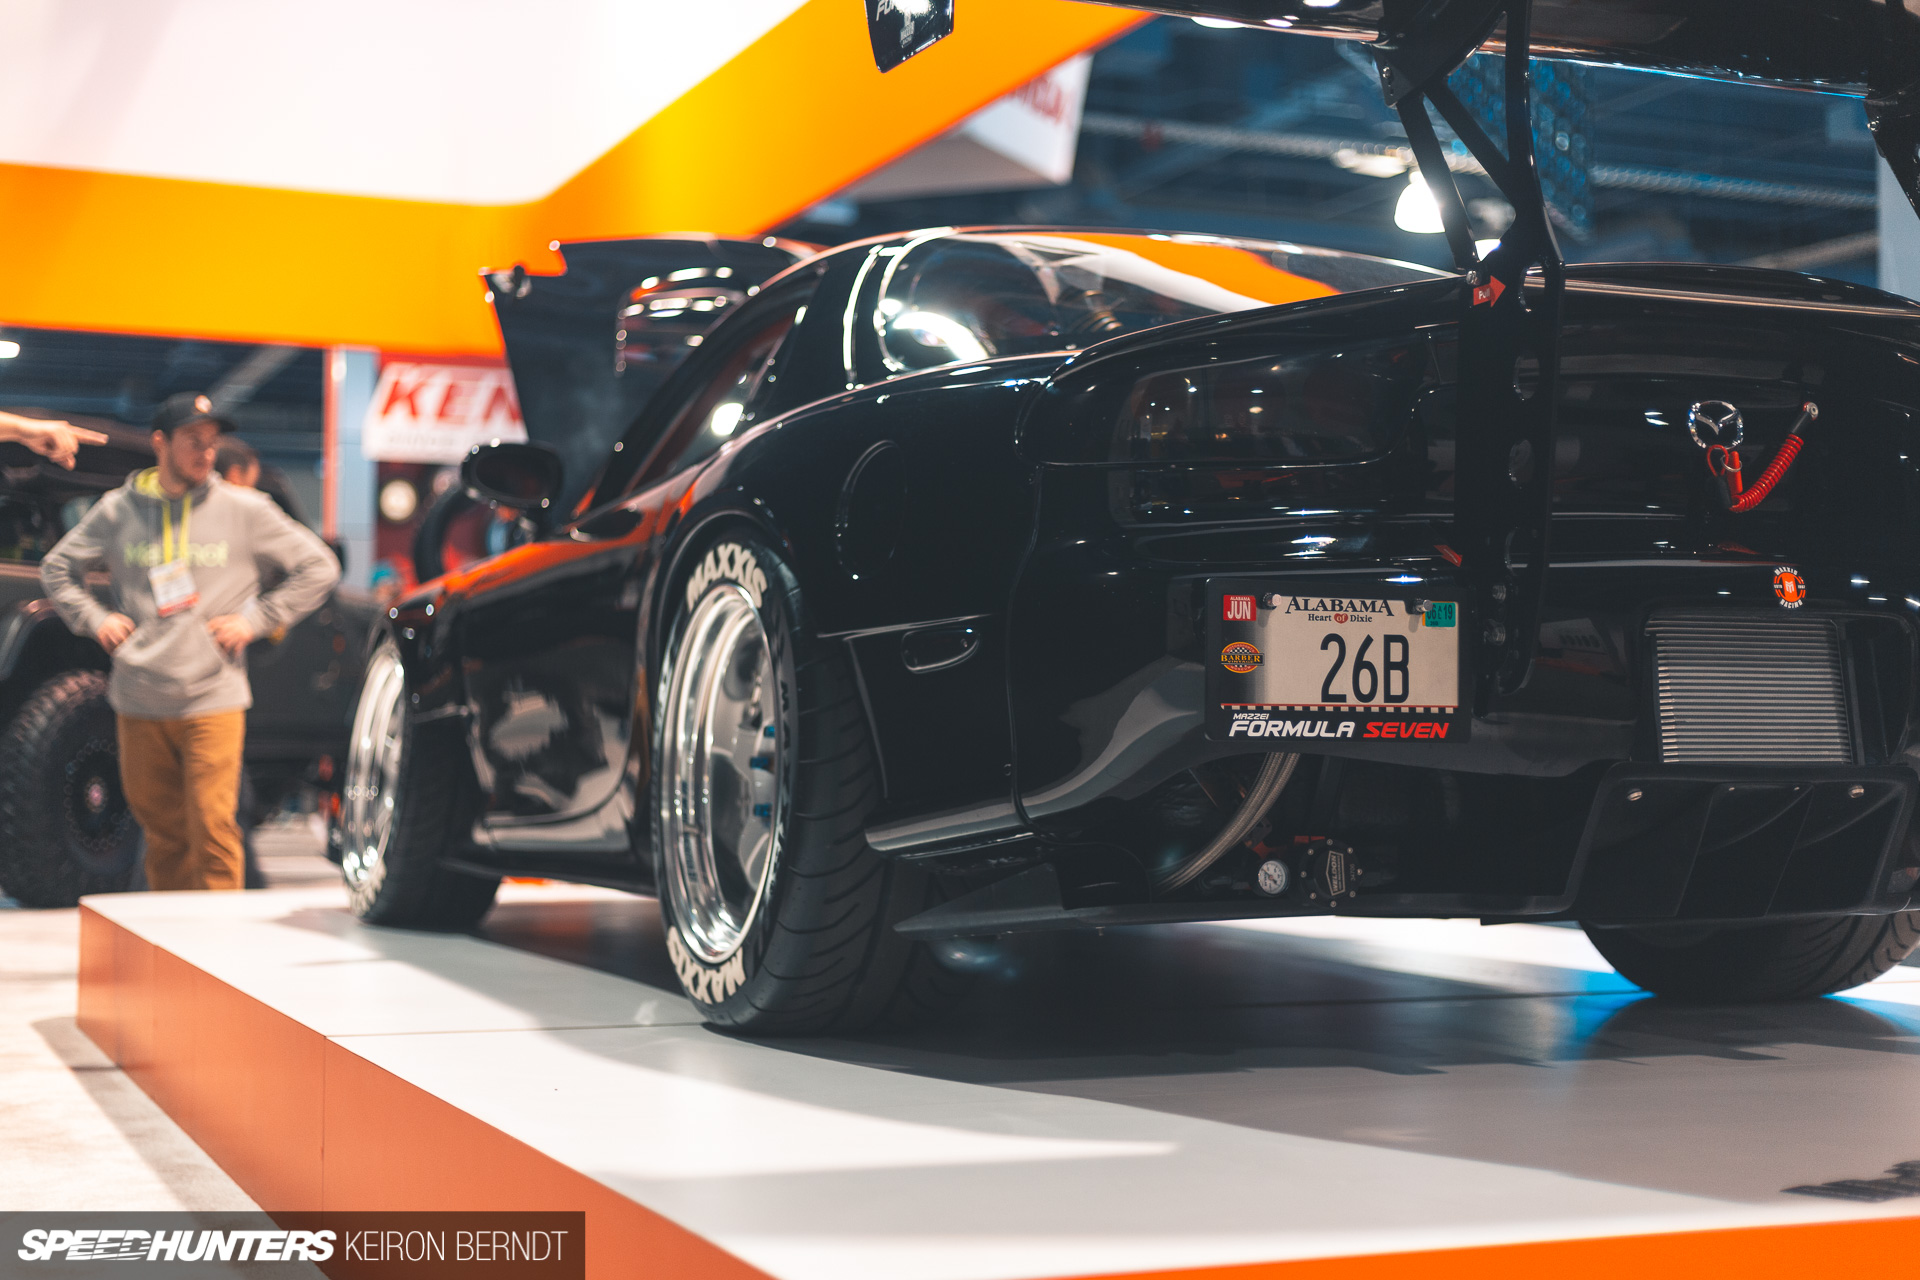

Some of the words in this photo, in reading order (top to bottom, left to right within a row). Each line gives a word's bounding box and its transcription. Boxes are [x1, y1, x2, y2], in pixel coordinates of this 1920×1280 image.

[686, 542, 768, 614] MAXXIS
[1774, 566, 1798, 576] MAXXIS
[1227, 600, 1251, 620] JUN
[1284, 595, 1395, 617] ALABAMA
[1443, 603, 1453, 620] 19
[1780, 599, 1803, 608] RACING
[1308, 613, 1332, 622] Heart
[1336, 615, 1346, 623] of
[1350, 614, 1373, 623] Dixie
[1221, 654, 1261, 663] BARBER
[1320, 632, 1410, 704] 26B
[1228, 720, 1356, 738] FORMULA
[1362, 722, 1450, 739] SEVEN
[666, 926, 746, 1005] MAXXIS
